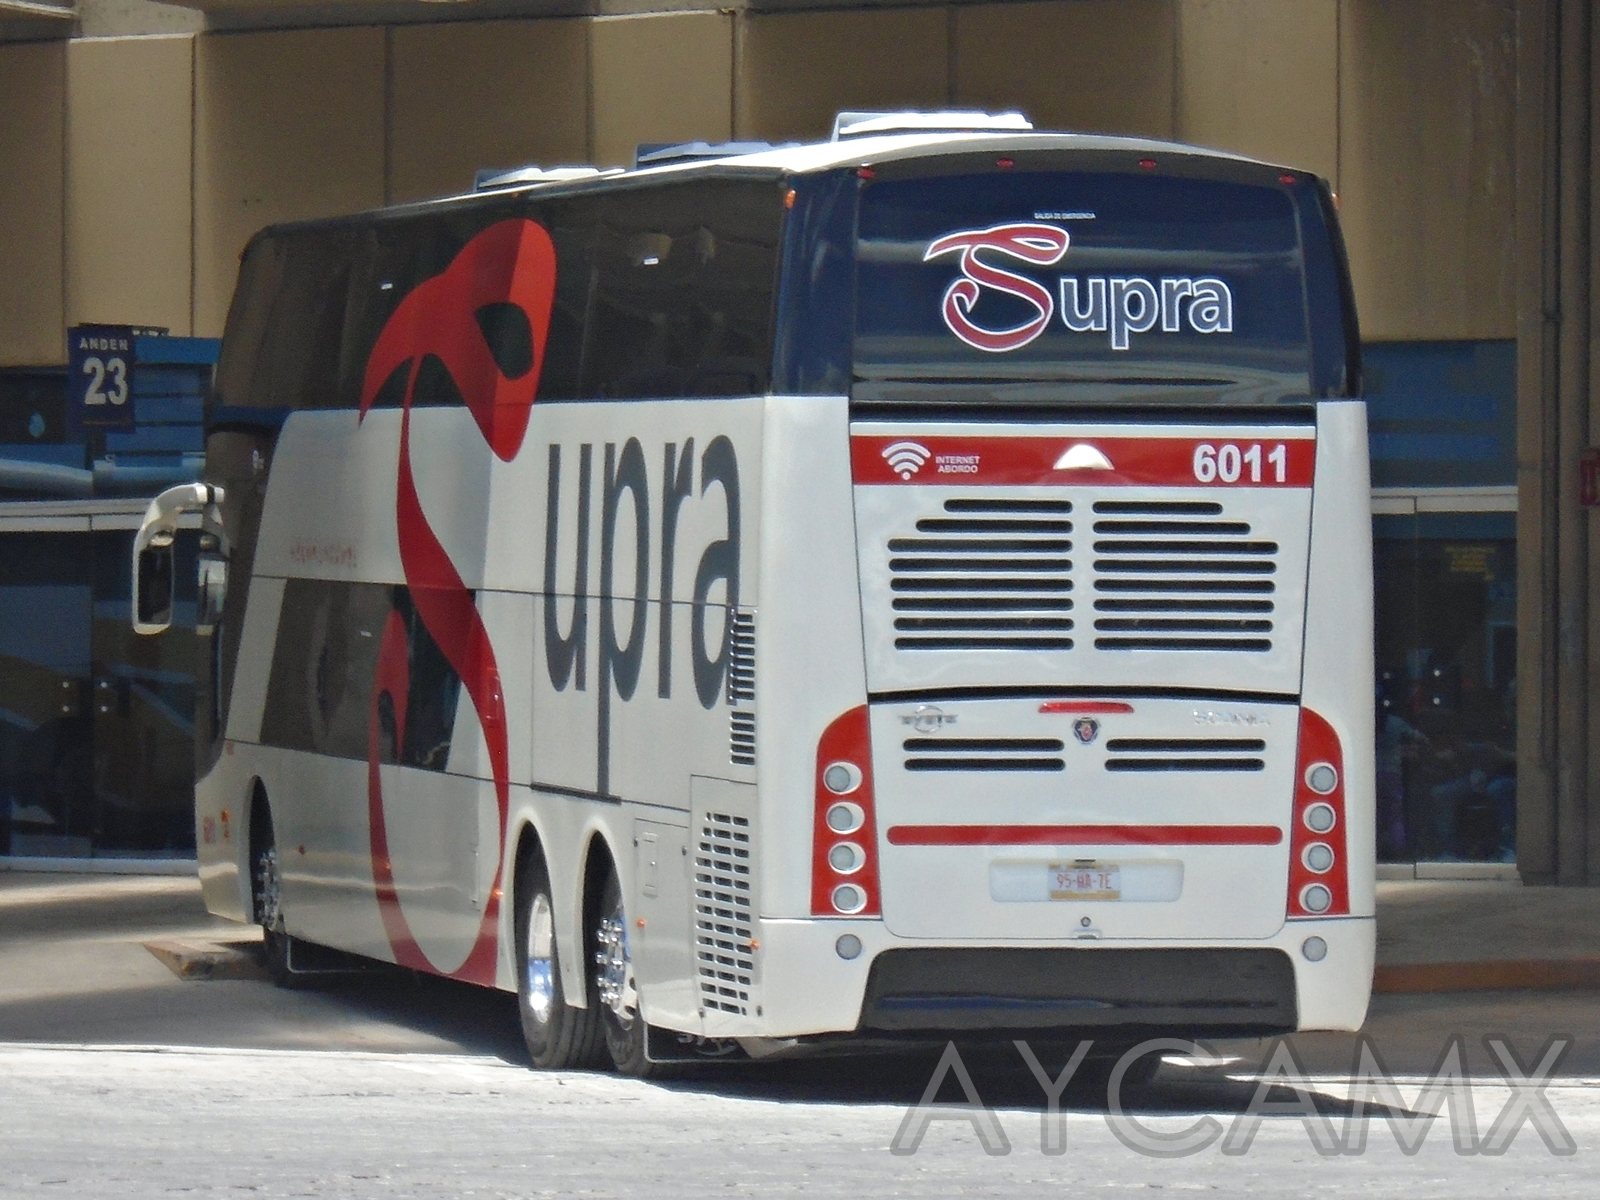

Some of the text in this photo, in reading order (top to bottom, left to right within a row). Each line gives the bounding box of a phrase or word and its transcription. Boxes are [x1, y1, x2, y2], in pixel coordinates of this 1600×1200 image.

[923, 222, 1233, 352] Supra
[79, 337, 128, 351] ANDEN
[83, 357, 128, 405] 23
[935, 455, 980, 464] INTERNET
[1193, 443, 1287, 484] 6011
